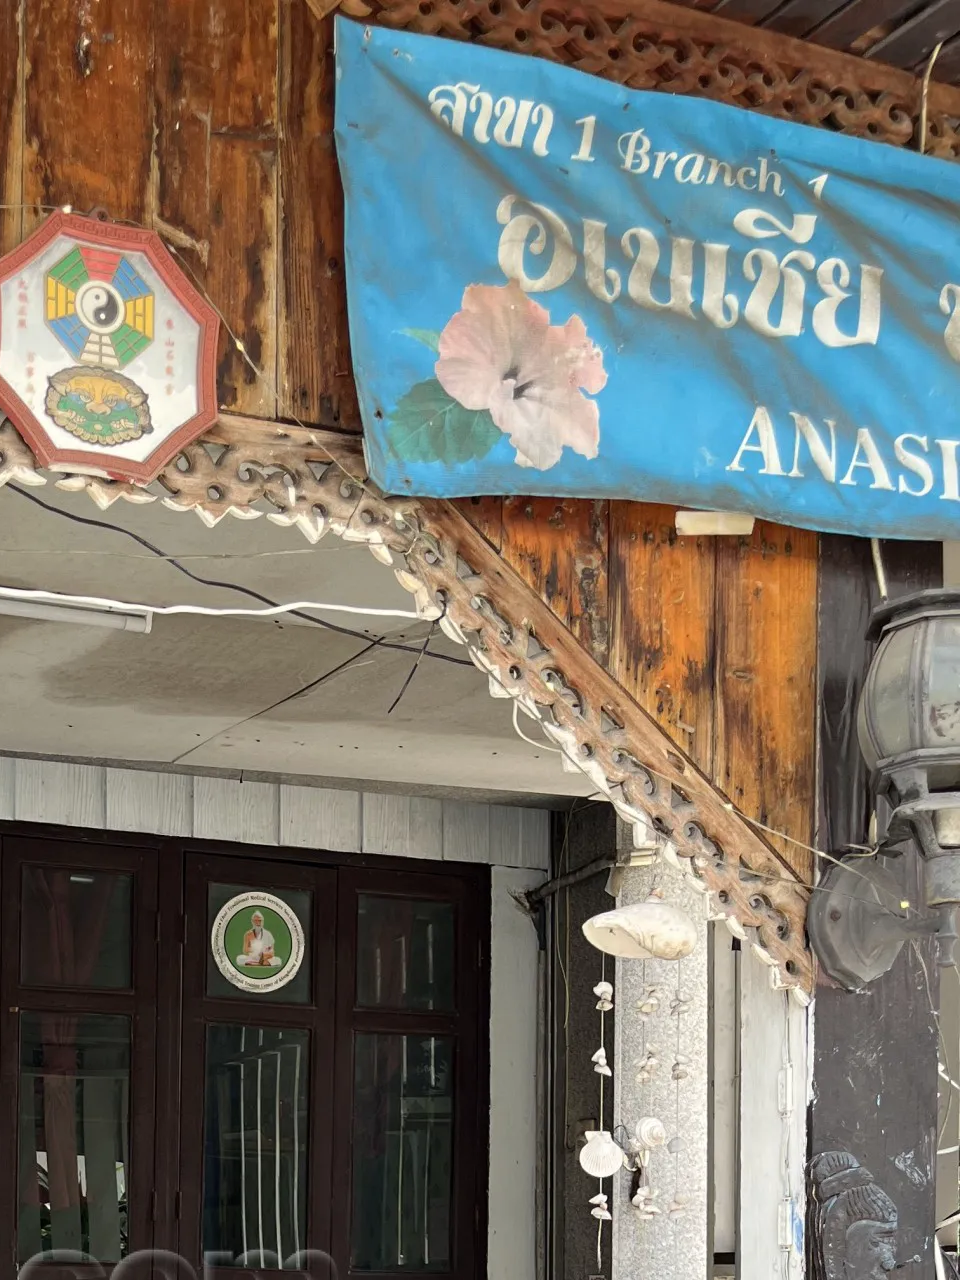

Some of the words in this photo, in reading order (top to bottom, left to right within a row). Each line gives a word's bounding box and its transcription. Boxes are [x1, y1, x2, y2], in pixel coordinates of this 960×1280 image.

[428, 82, 554, 157] สาขา
[570, 115, 596, 162] 1
[617, 128, 785, 198] Branch
